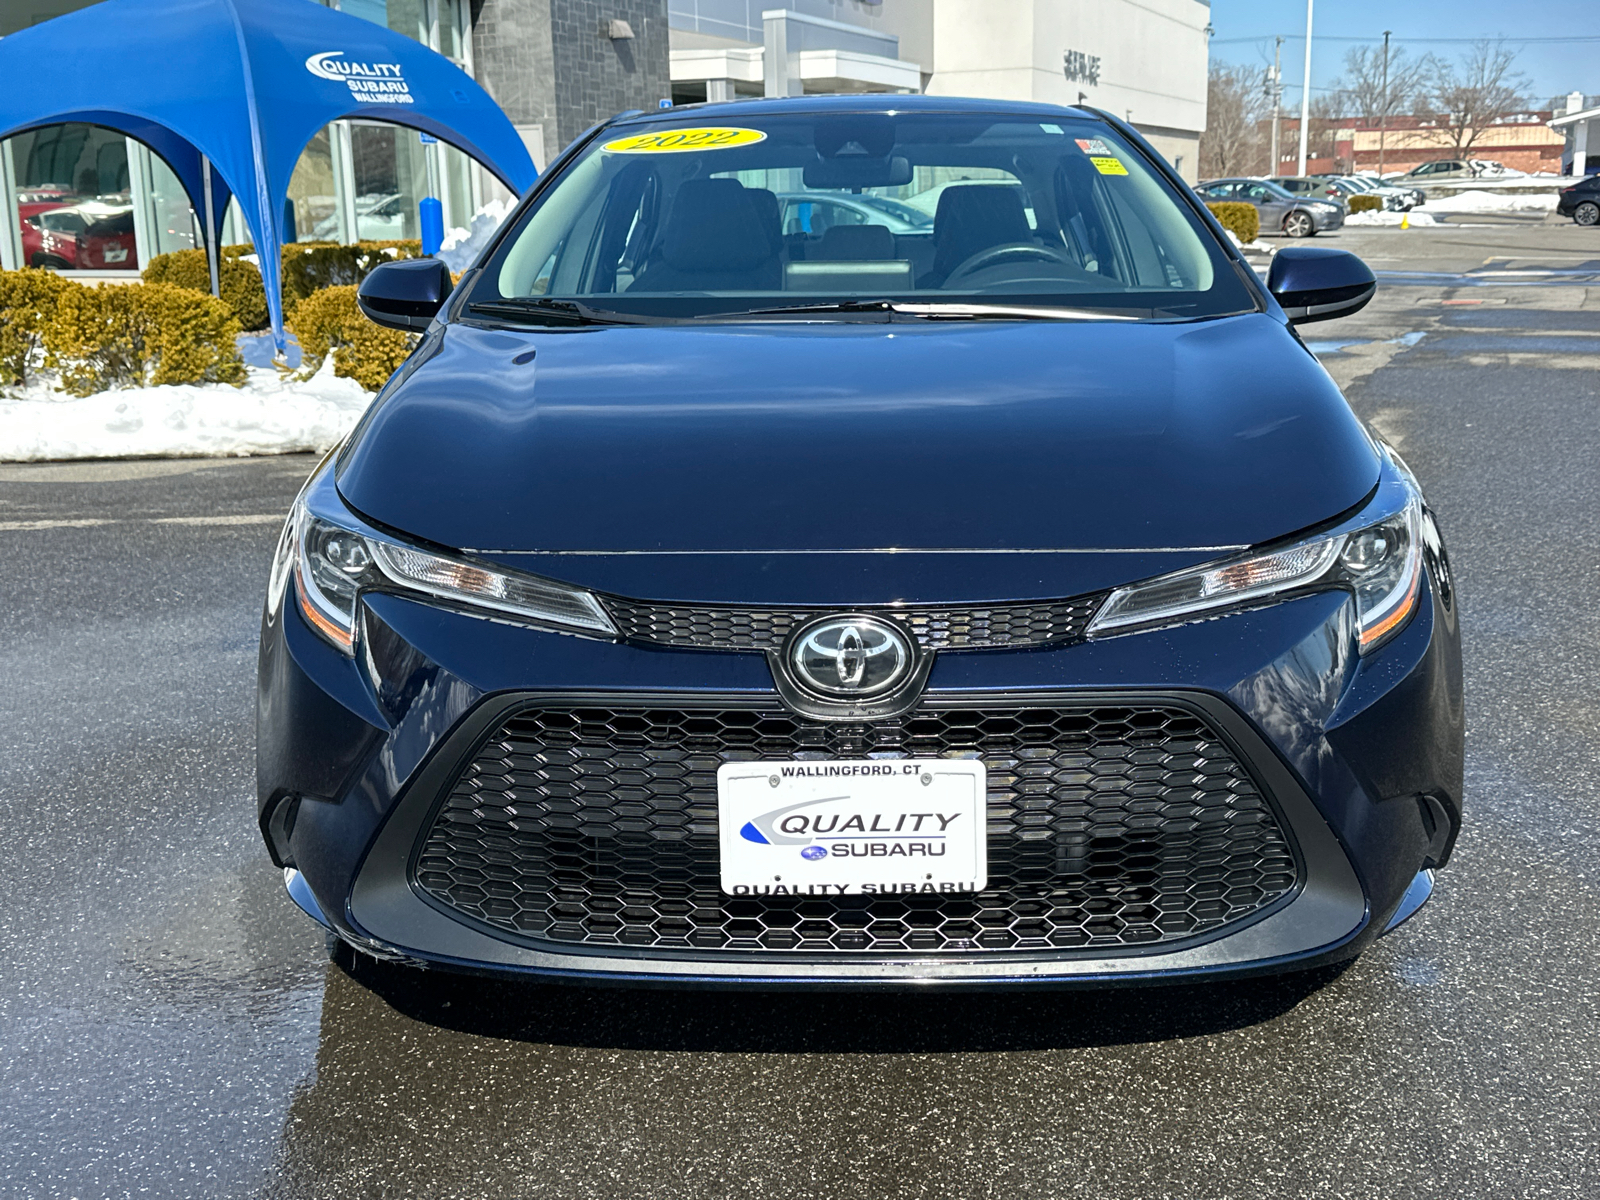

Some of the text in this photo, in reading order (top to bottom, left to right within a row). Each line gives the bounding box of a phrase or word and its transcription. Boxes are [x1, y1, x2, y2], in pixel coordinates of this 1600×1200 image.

[321, 60, 401, 77] QUALITY
[346, 80, 409, 93] SUBARU
[351, 92, 414, 104] WALLINGFORD
[626, 131, 740, 150] 2022
[780, 765, 922, 777] WALLINGFORD, CT
[780, 813, 962, 834] QUALITY
[831, 843, 946, 857] SUBARU
[732, 882, 976, 895] QUALITY SUBARU
